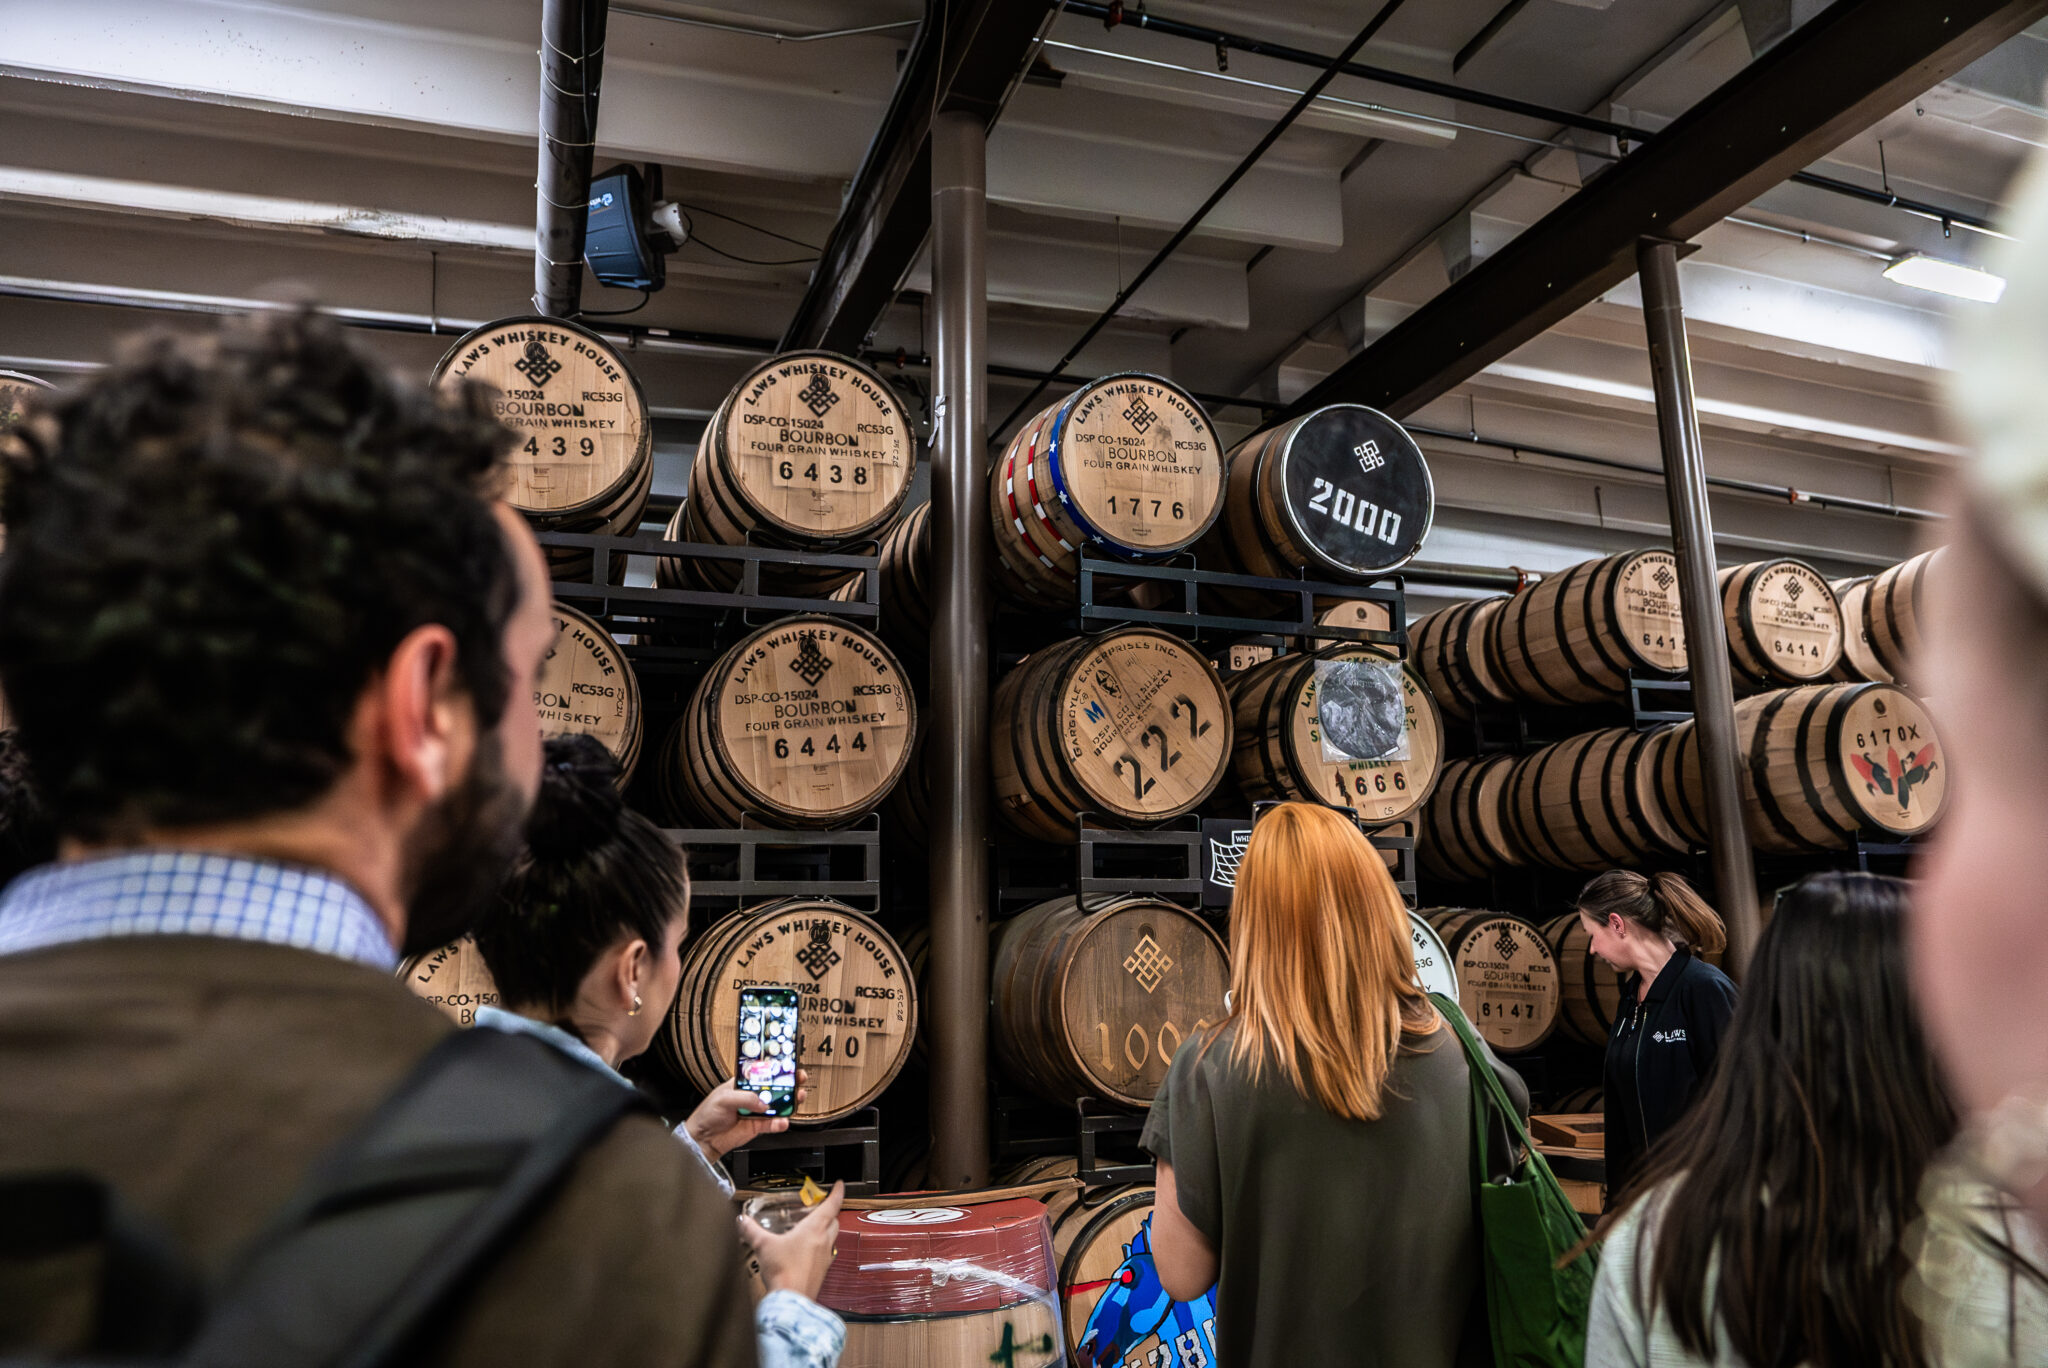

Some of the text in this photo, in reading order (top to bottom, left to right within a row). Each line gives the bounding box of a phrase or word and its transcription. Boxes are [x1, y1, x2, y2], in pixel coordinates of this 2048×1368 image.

[455, 330, 621, 383] LAWS WHISKEY HOUSE
[582, 392, 623, 402] RC53G
[745, 364, 892, 416] LAWS WHISKEY HOUSE
[496, 402, 584, 416] BOURBON
[1075, 384, 1204, 434] LAWS WHISKEY HOUSE
[552, 420, 615, 429] WHISKEY
[744, 415, 894, 435] DSP-CO-15024 RC53G
[524, 437, 594, 456] 439
[780, 429, 859, 446] BOURBON
[1175, 441, 1206, 451] RC53G
[752, 441, 886, 459] FOUR GRAIN WHISKEY
[1109, 447, 1177, 463] BOURBON
[780, 461, 867, 485] 6438
[1084, 460, 1201, 475] FOUR GRAIN WHISKEY
[1108, 496, 1184, 520] 1776
[1309, 477, 1402, 545] 2000
[572, 629, 616, 676] HOUSE
[734, 629, 888, 684] LAWS WHISKEY HOUSE
[1775, 641, 1818, 658] 6414
[572, 683, 614, 698] RC53G
[735, 684, 891, 705] DSP-CO-15024 RC53G
[1069, 684, 1082, 758] GARGOYLE
[1079, 642, 1150, 683] ENTERPRISES
[1136, 670, 1172, 710] WHISKEY
[1301, 681, 1316, 708] LAW
[774, 700, 857, 718] BOURBON
[746, 713, 886, 731] FOUR GRAIN WHISKEY
[774, 732, 867, 759] 6444
[1113, 694, 1212, 800] 222
[737, 931, 775, 967] LAWS
[777, 919, 852, 937] WHISKEY
[855, 933, 896, 979] HOUSE
[1464, 921, 1549, 959] LAWS WHISKEY HOUSE
[417, 944, 459, 983] LAWS
[1484, 971, 1530, 982] BOURBON
[855, 986, 895, 1000] RC53G
[1482, 1003, 1533, 1019] 6147
[823, 1015, 885, 1028] WHISKEY
[1665, 1029, 1686, 1039] LAWS
[1096, 1018, 1210, 1072] 100
